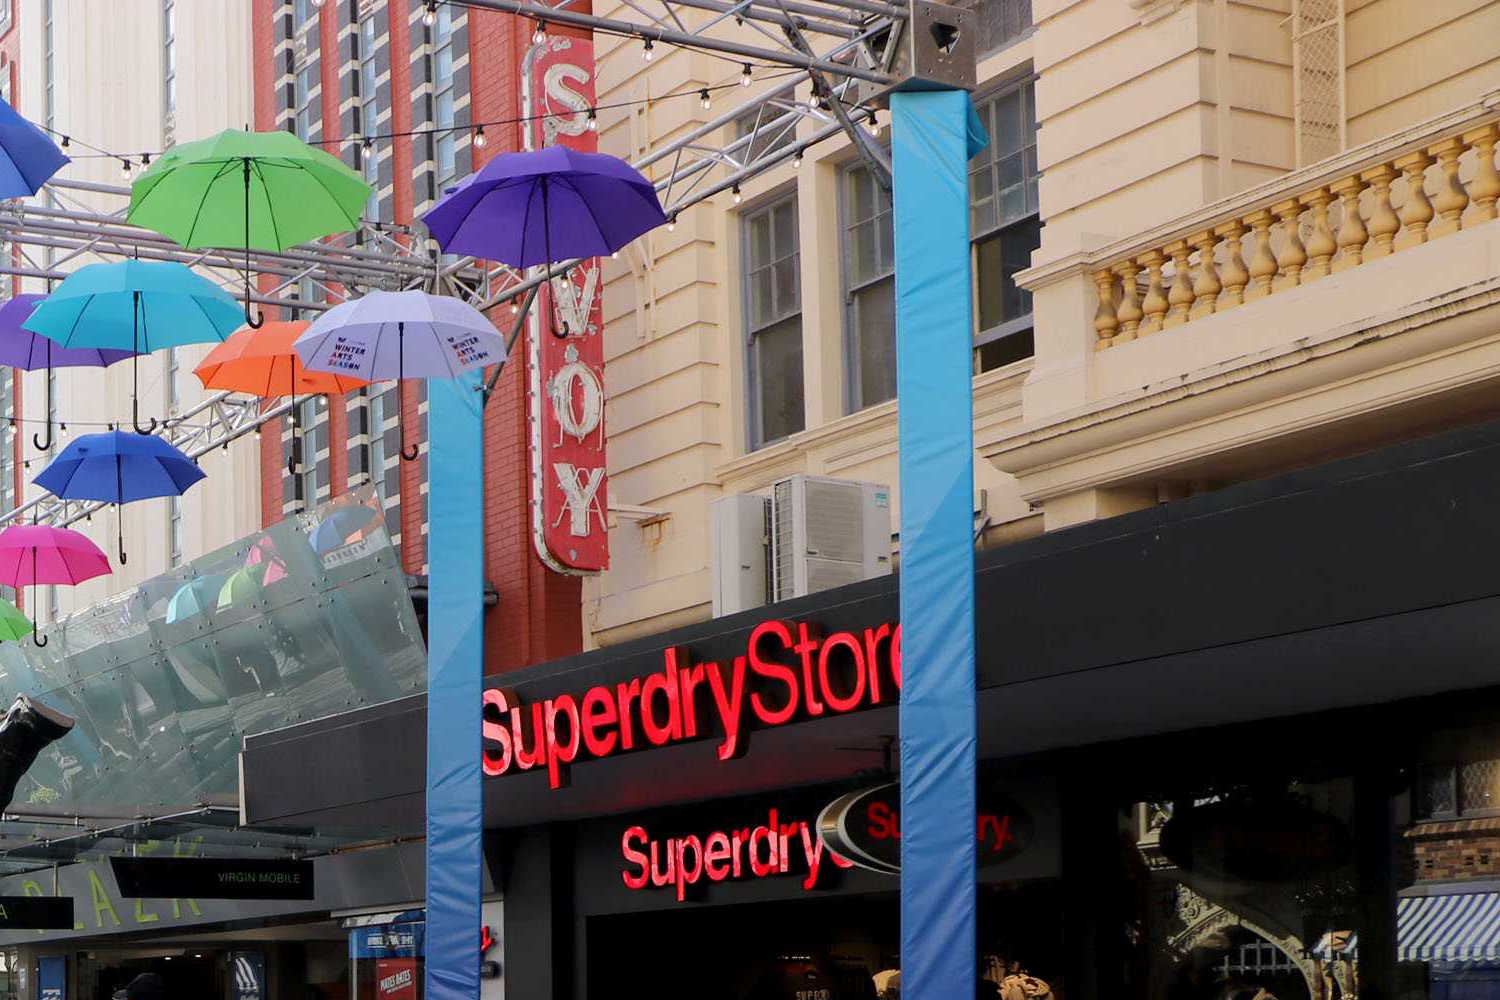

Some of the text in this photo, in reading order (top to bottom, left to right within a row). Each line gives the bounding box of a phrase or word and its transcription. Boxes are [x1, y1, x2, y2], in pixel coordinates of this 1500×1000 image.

[544, 63, 606, 537] SVOY
[335, 343, 366, 356] WINTER
[451, 336, 479, 350] WINTER
[331, 352, 353, 361] ARTS
[621, 808, 852, 901] Superdry
[218, 872, 300, 883] VIRGIN MOBILE
